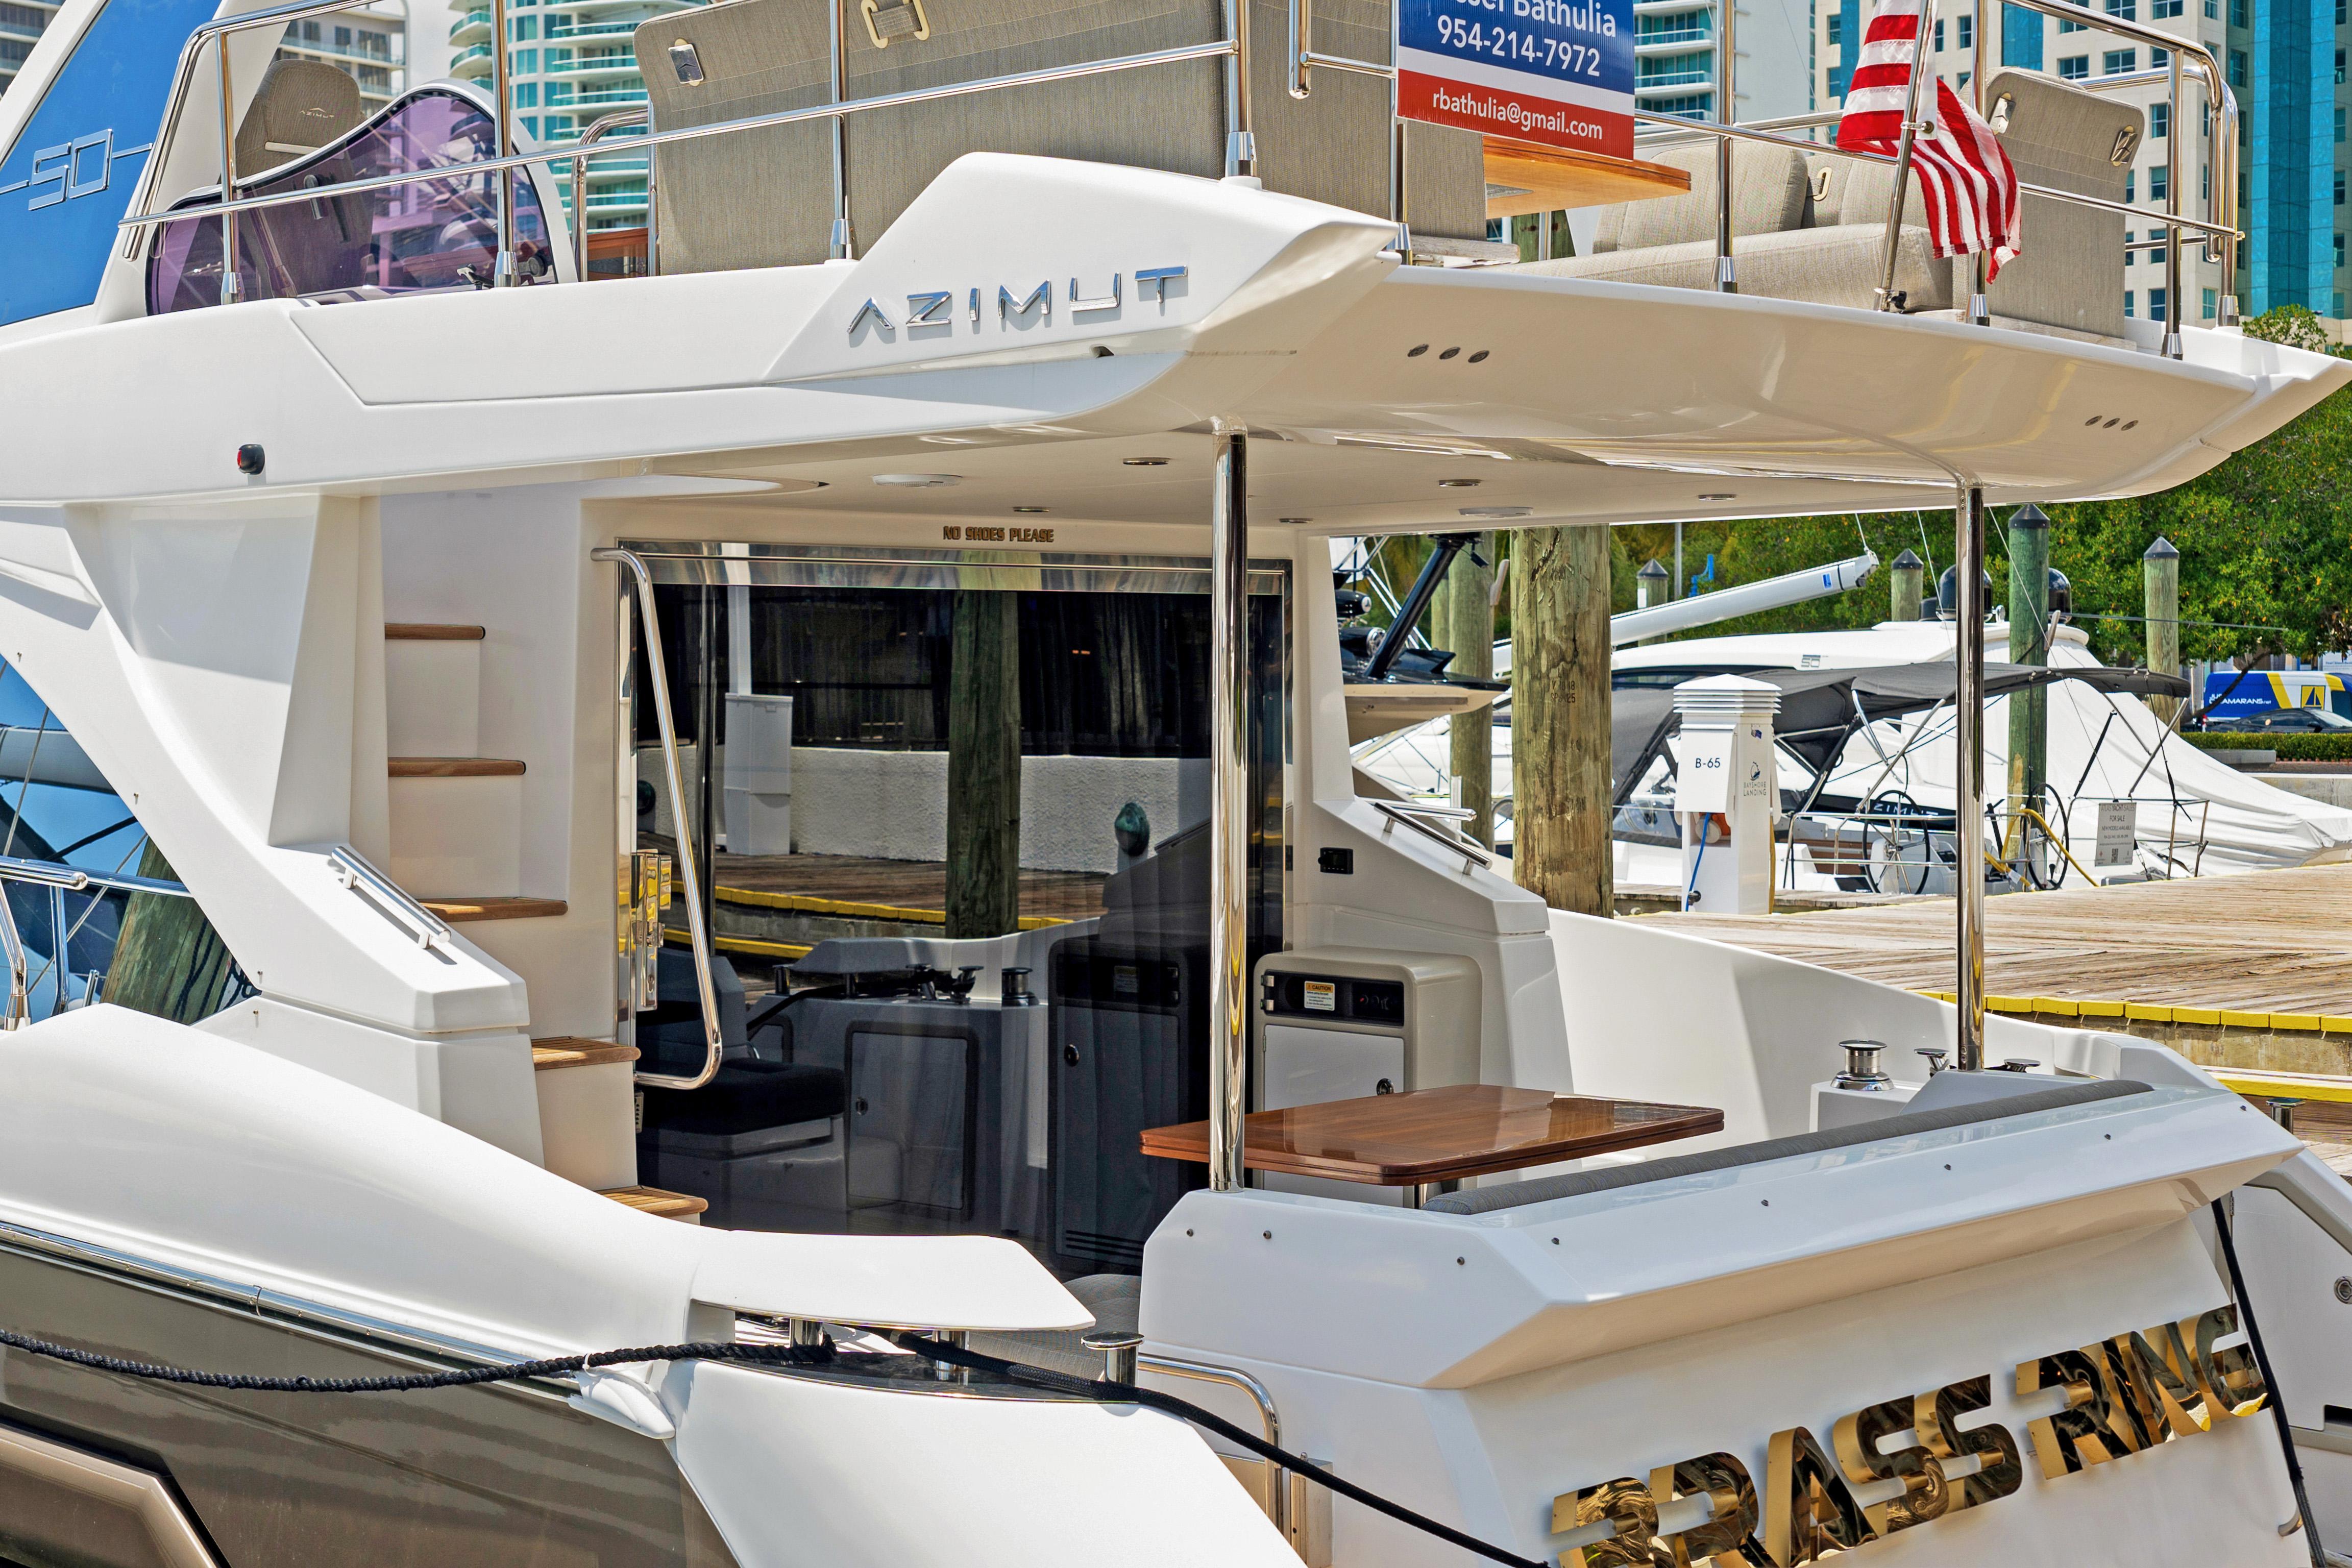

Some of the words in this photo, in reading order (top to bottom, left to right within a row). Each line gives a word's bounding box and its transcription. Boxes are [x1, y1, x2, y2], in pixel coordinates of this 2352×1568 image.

[1514, 0, 1616, 37] Bathulia
[1437, 15, 1600, 77] 954-214-7972
[1433, 87, 1603, 140] rbathulia@gmail.com
[847, 265, 1188, 334] AZIMUT
[943, 526, 961, 540] NO
[965, 526, 1006, 541] SHOES
[1009, 528, 1055, 543] PLEASE
[1696, 757, 1721, 768] B-65
[1551, 1373, 2023, 1568] BRASS
[2016, 1303, 2269, 1480] RING
